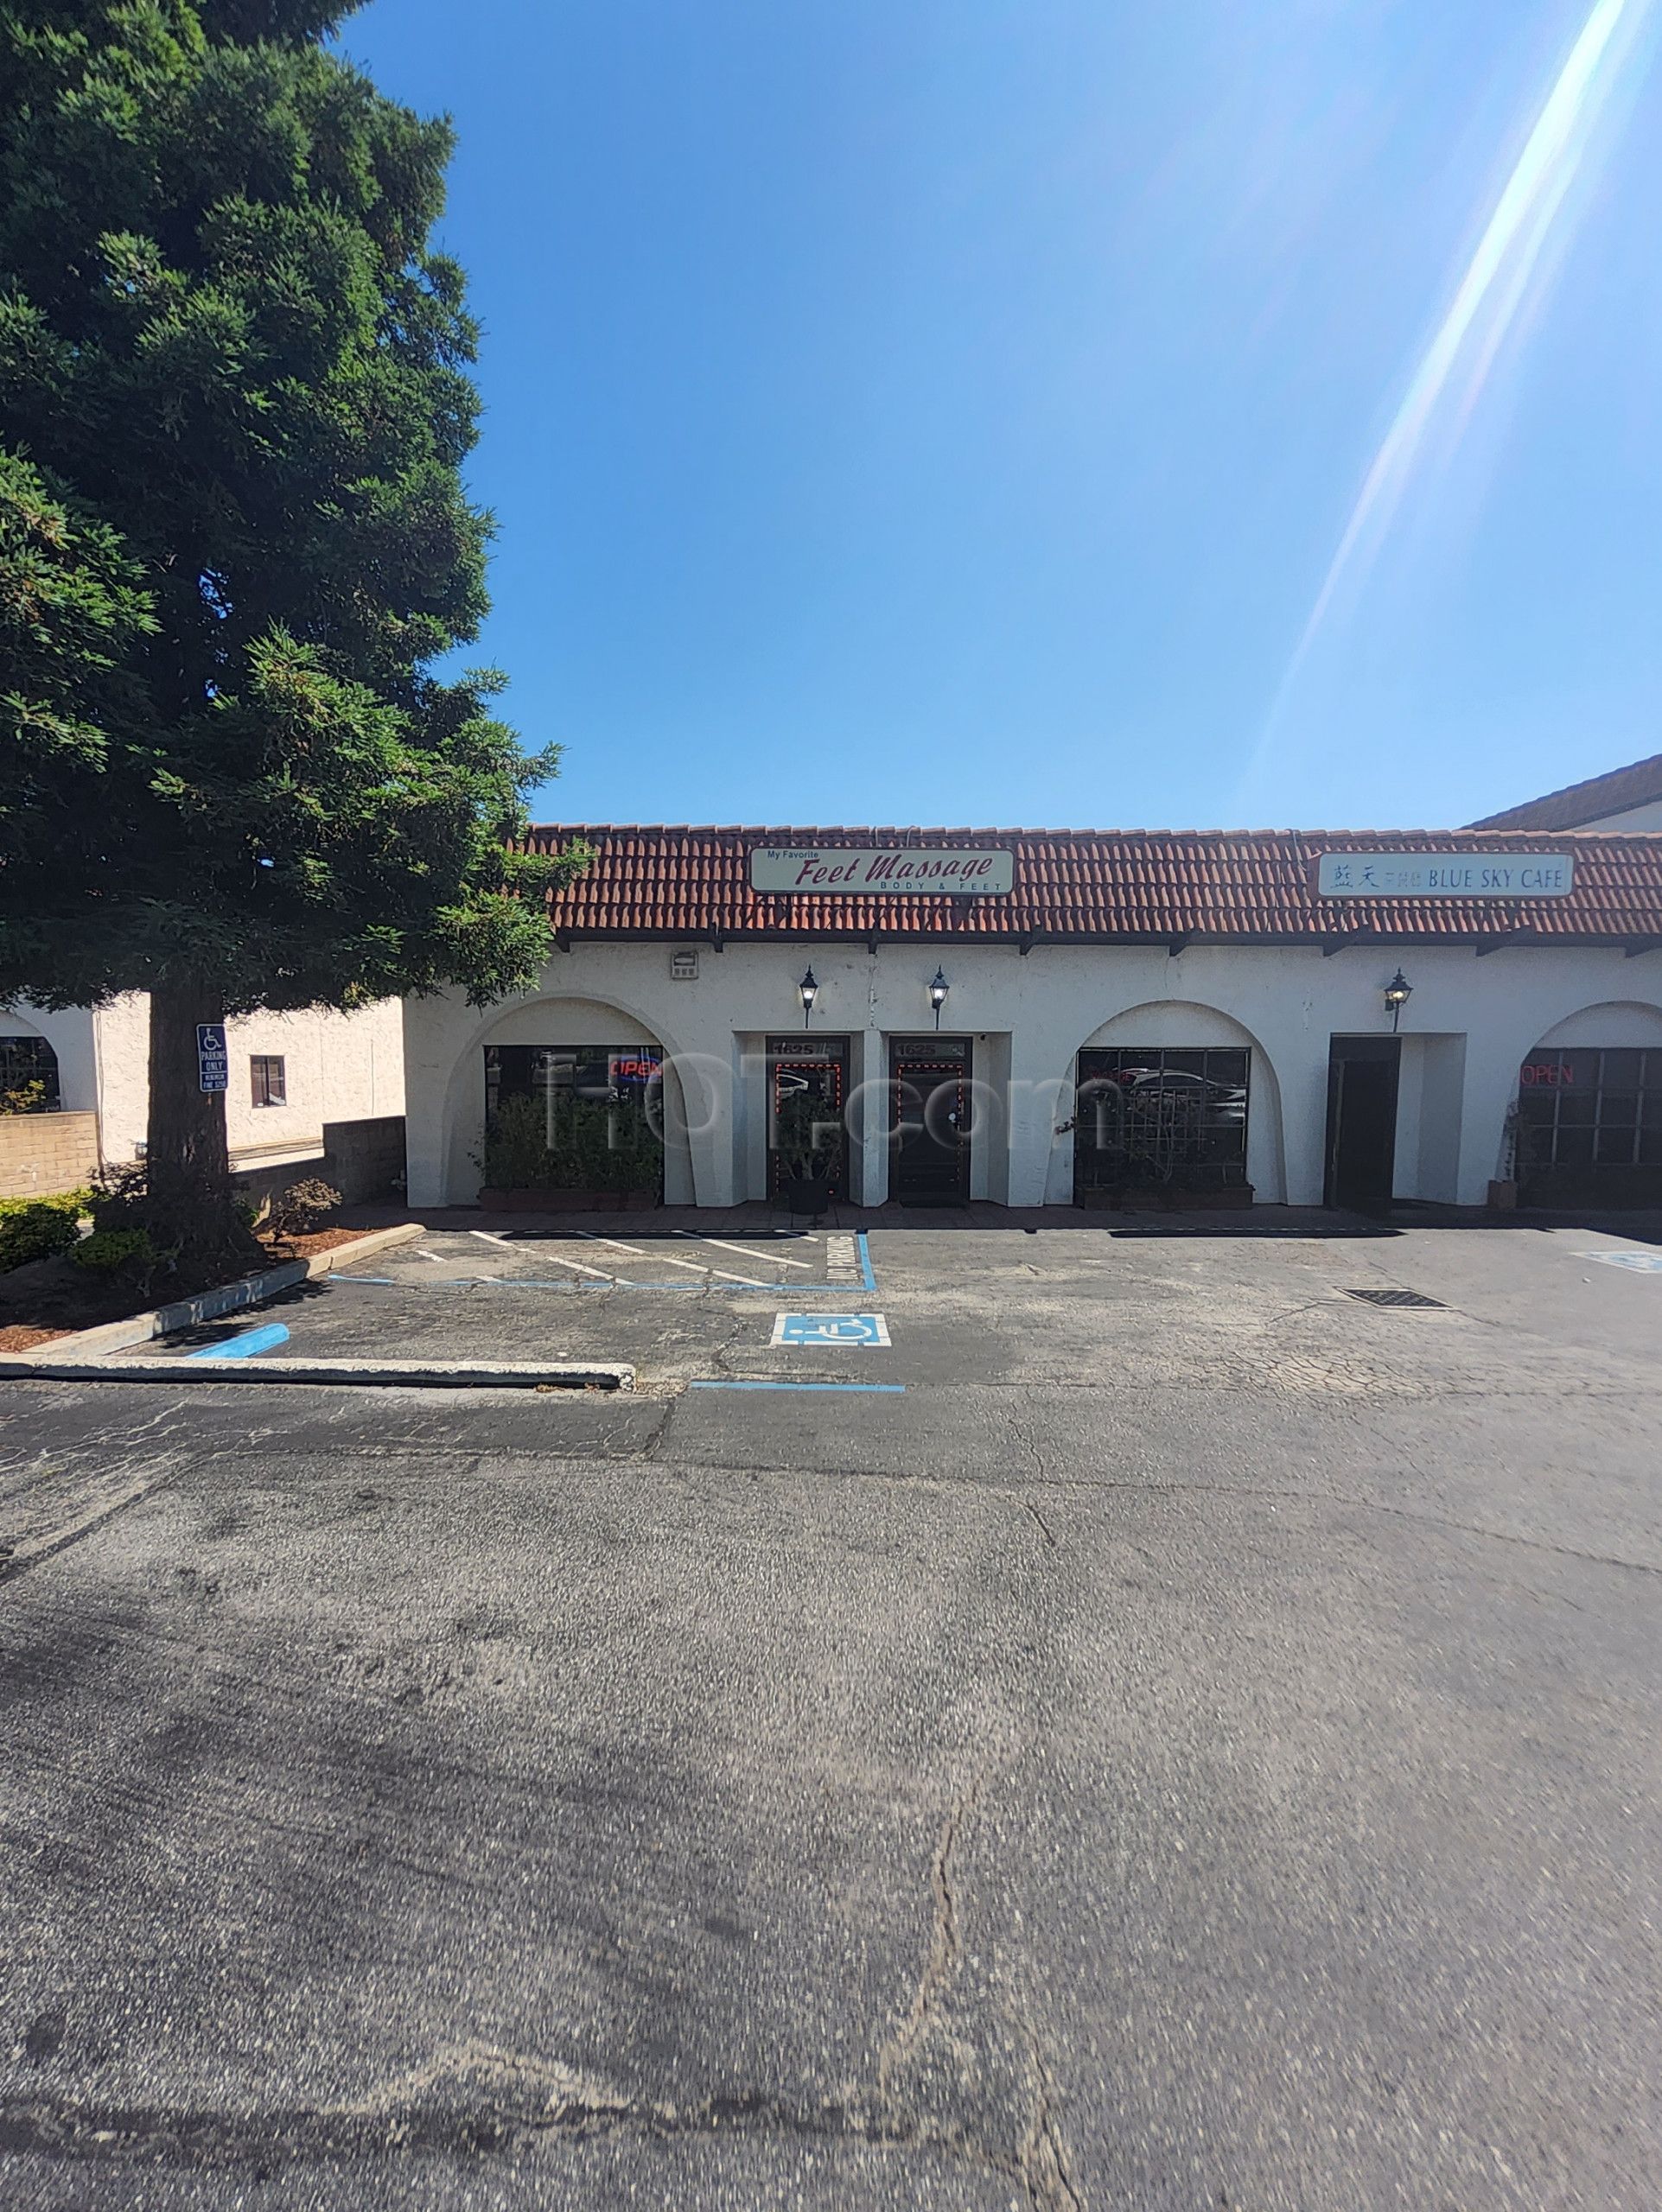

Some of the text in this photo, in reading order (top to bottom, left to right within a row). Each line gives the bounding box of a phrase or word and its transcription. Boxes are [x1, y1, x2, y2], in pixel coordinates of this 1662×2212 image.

[767, 850, 818, 860] My Favorite
[795, 854, 993, 886] Feet Massage
[881, 881, 925, 890] BODY
[1429, 869, 1472, 888] BLUE
[1481, 869, 1513, 888] SKY
[1521, 869, 1563, 888] CAFE
[201, 1051, 226, 1061] PARKING
[897, 1044, 936, 1055] 1625
[206, 1061, 223, 1071] ONLY
[610, 1060, 664, 1077] OPEN
[1521, 1065, 1574, 1084] OPEN
[826, 1236, 858, 1280] NO PARKING
